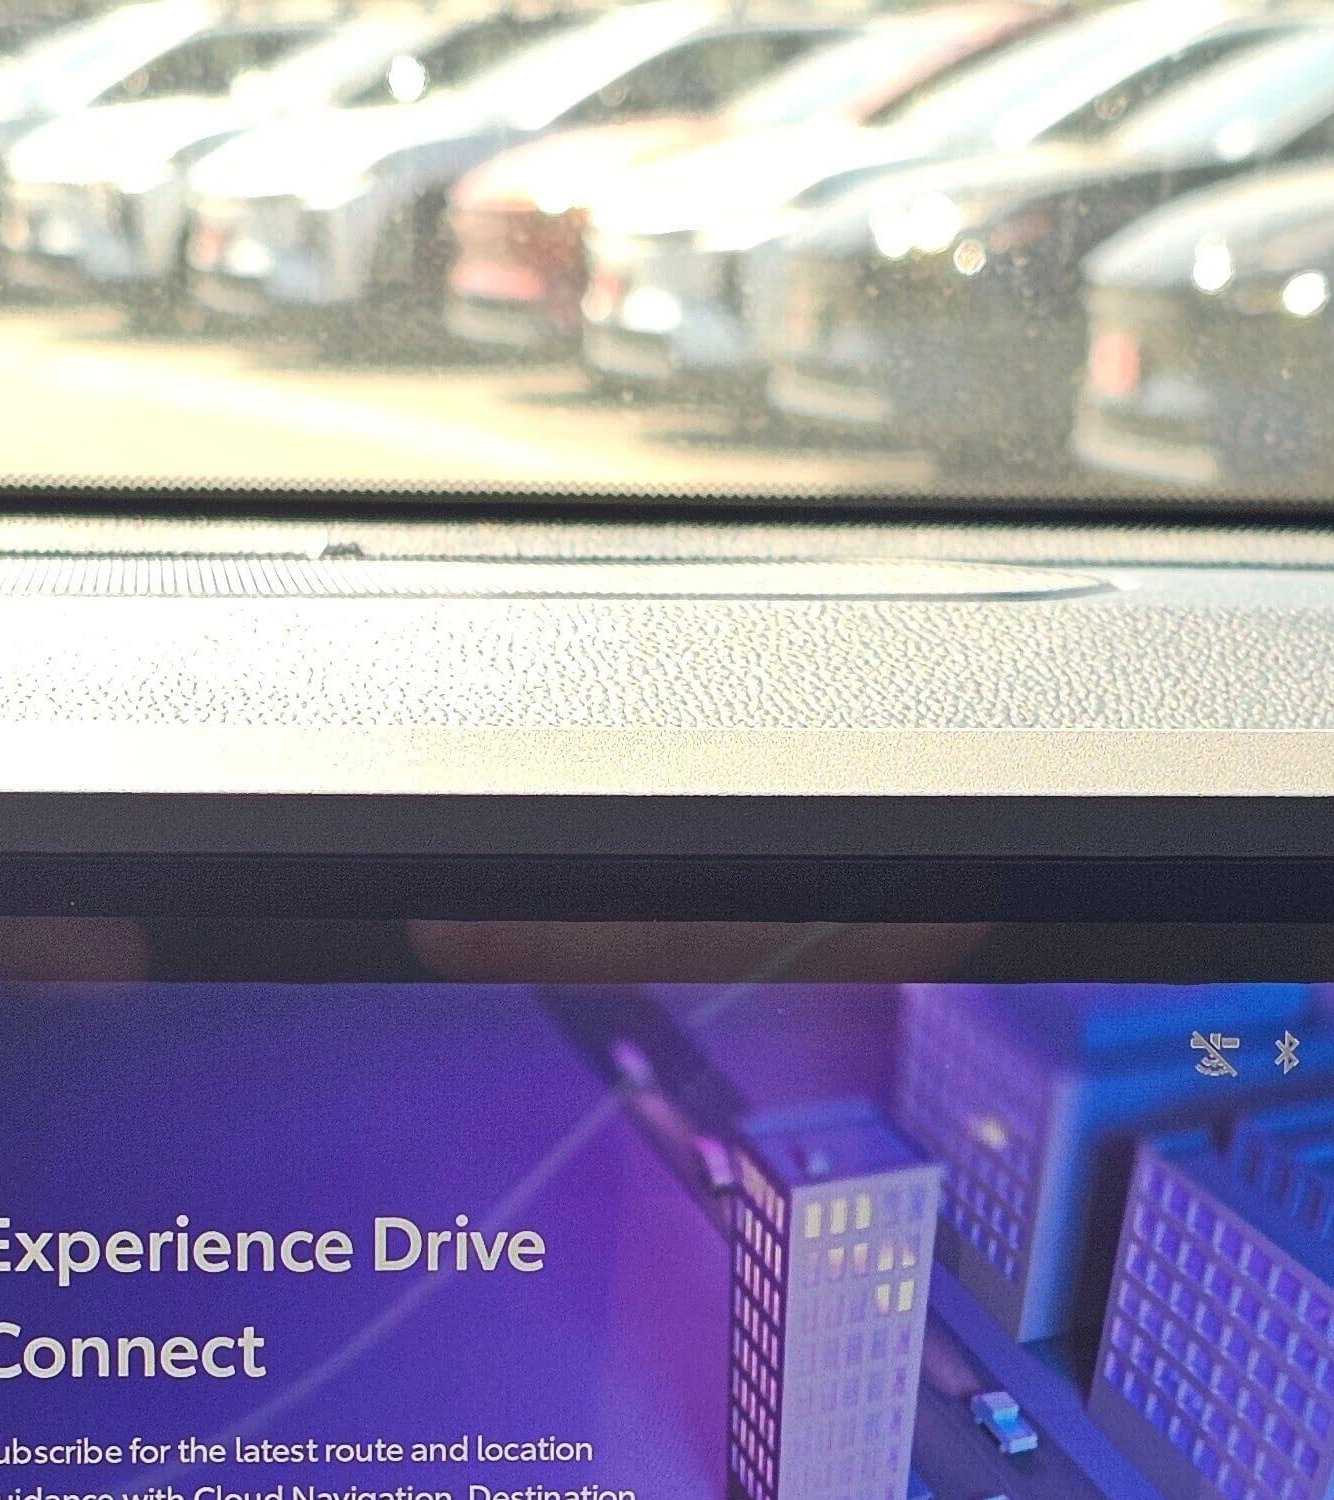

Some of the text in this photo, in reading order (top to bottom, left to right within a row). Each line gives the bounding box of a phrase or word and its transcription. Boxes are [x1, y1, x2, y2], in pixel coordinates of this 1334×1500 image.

[373, 1214, 545, 1273] Drive
[129, 1437, 172, 1465] for
[178, 1436, 227, 1465] the
[234, 1436, 318, 1464] latest
[325, 1438, 404, 1463] route
[411, 1435, 468, 1463] and
[477, 1435, 594, 1463] location
